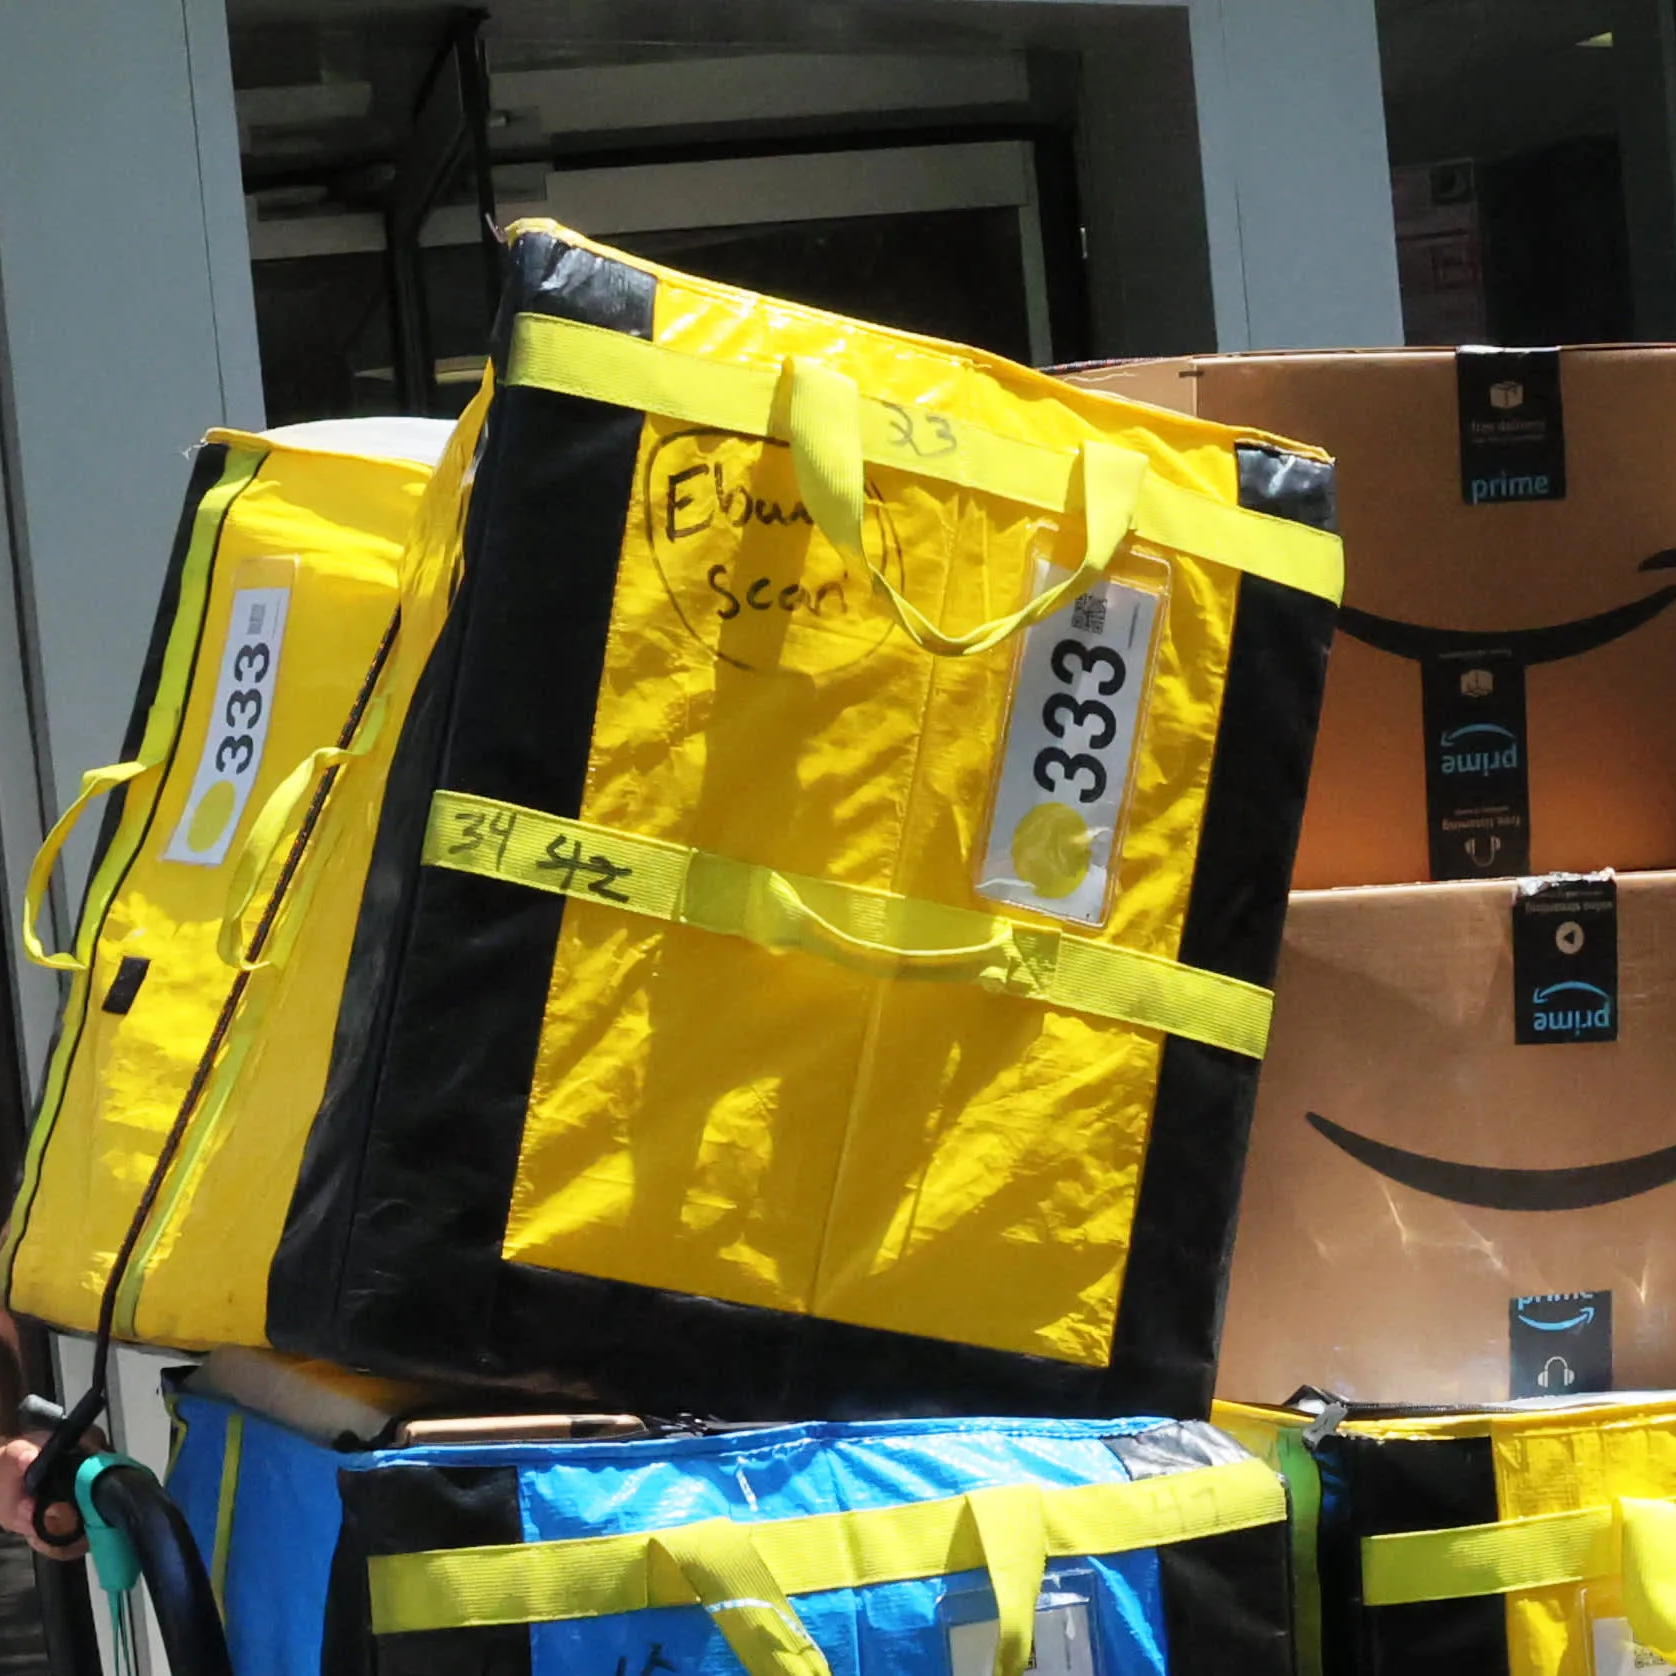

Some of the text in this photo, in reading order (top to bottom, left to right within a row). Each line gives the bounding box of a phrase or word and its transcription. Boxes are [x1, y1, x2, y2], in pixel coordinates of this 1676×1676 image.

[1470, 470, 1550, 507] prime
[215, 641, 271, 775] 333
[1032, 637, 1128, 804] 333
[1439, 743, 1518, 777] prime
[1532, 1001, 1612, 1037] prime
